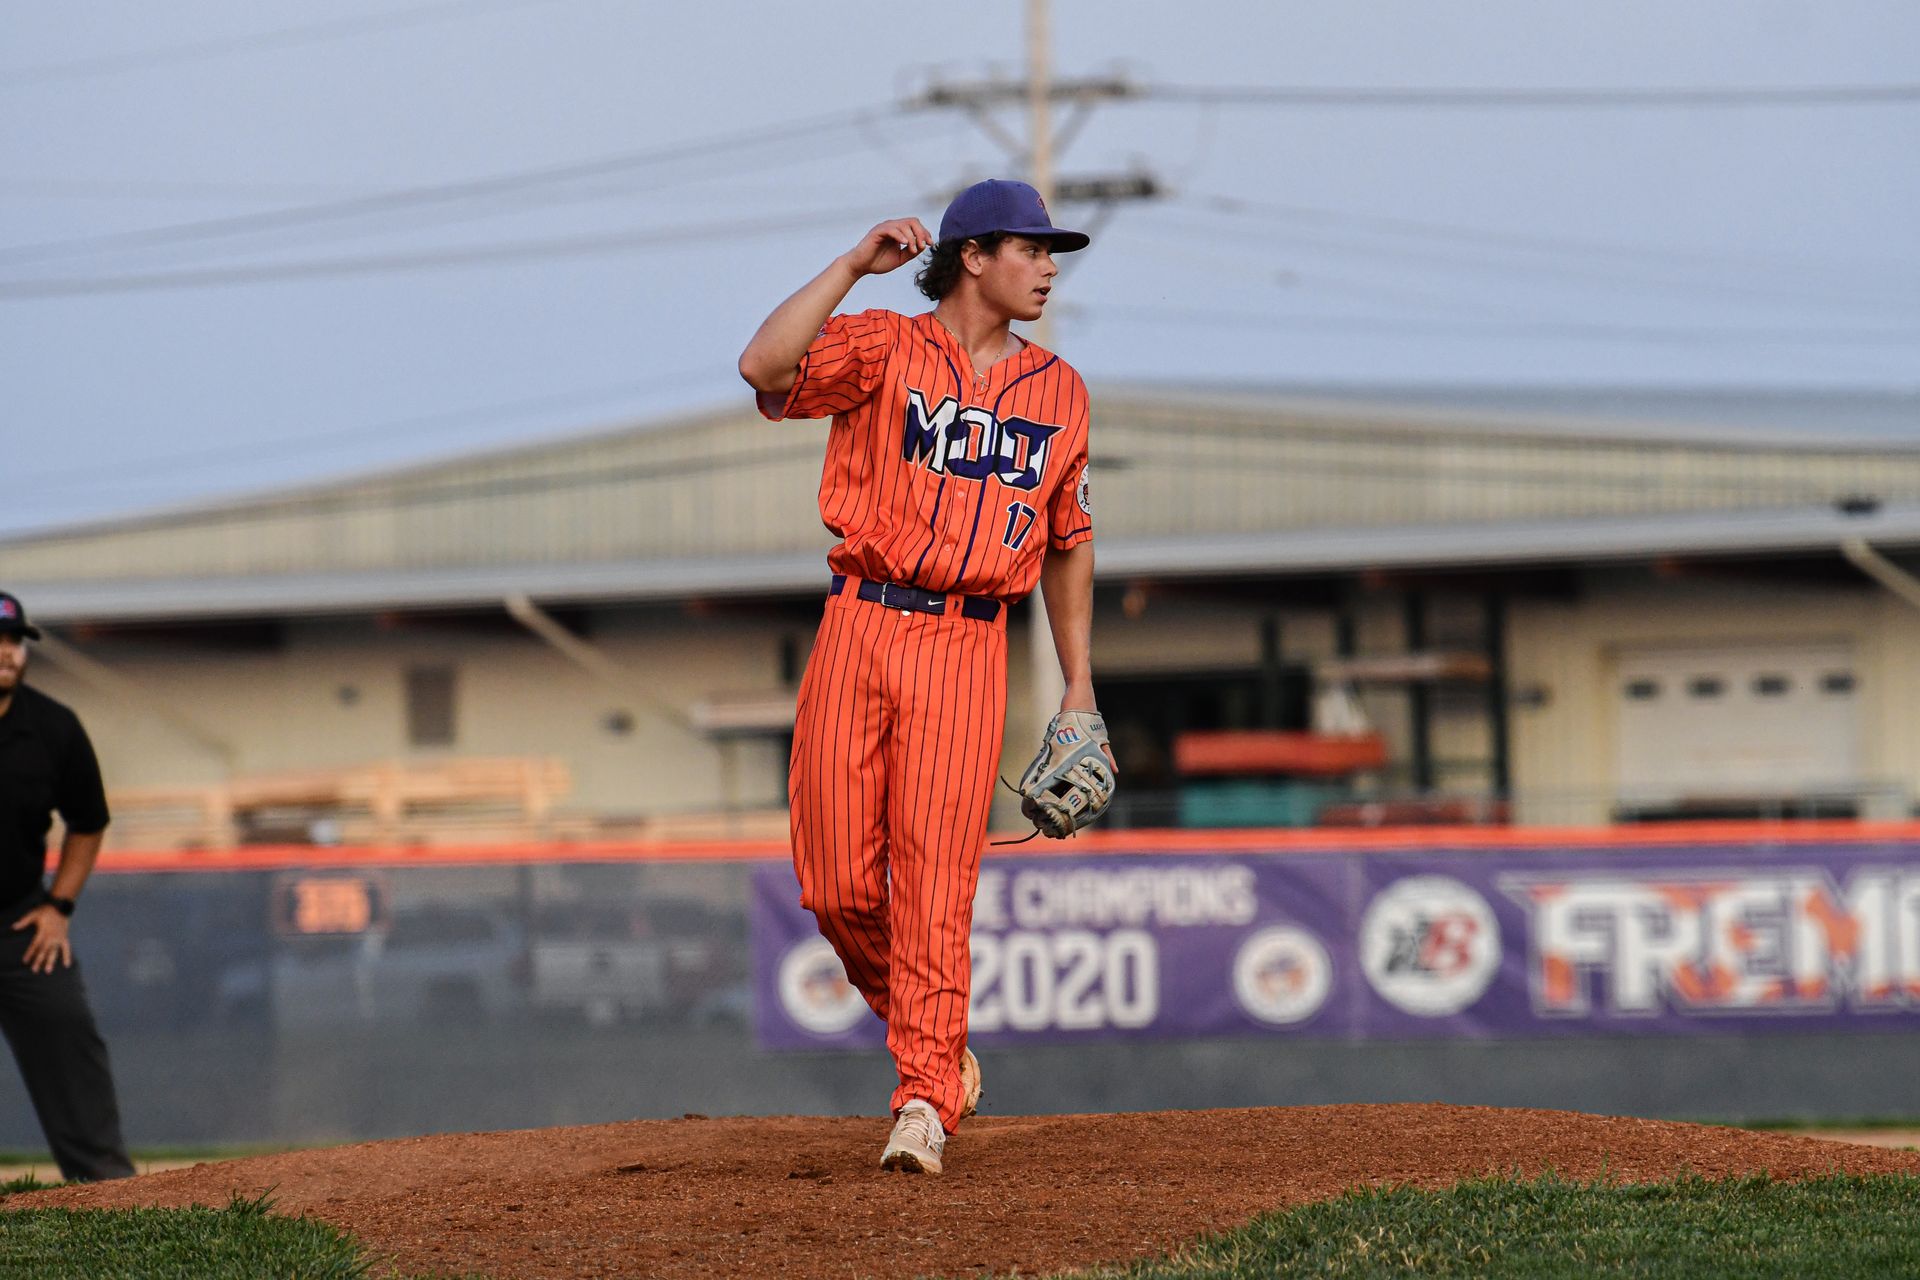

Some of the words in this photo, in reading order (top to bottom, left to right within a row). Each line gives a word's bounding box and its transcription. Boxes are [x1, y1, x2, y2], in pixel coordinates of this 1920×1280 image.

[901, 384, 1065, 493] MOO
[1002, 501, 1037, 551] 17
[1012, 864, 1257, 926] CHAMPIONS
[969, 930, 1158, 1030] 2020
